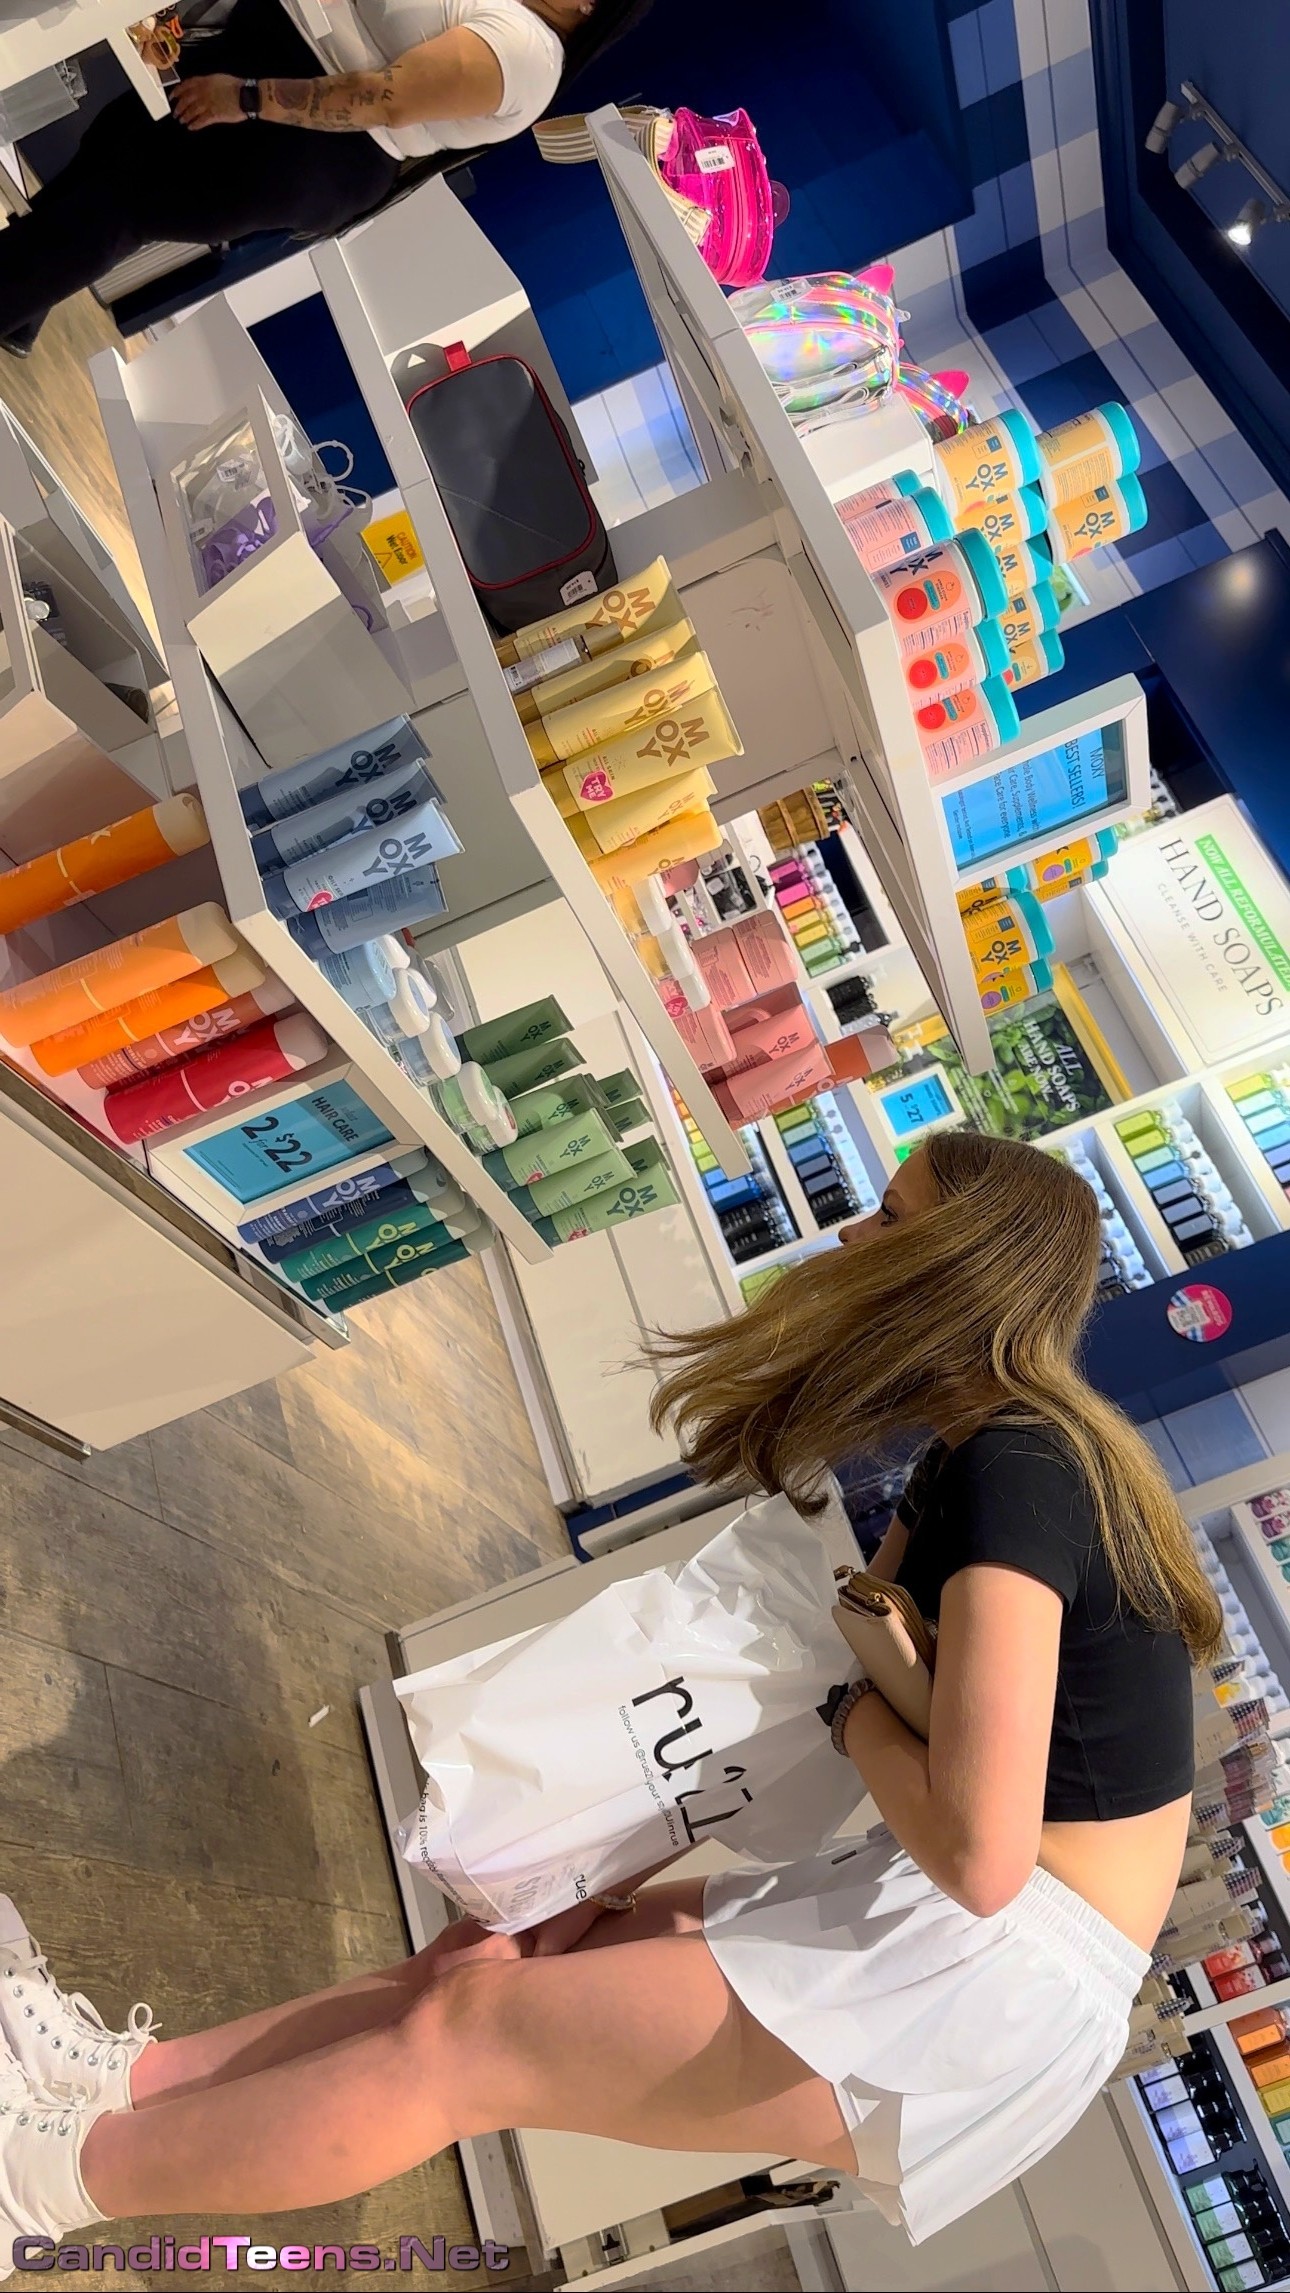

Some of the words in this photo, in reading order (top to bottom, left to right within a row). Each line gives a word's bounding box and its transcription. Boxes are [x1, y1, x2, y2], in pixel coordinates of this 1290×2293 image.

[979, 512, 1016, 542] MOX
[386, 535, 397, 549] Wet
[398, 531, 417, 559] CAUTION
[1000, 620, 1032, 645] MOX
[635, 715, 710, 767] MOXY
[1063, 738, 1080, 765] BEST
[605, 765, 615, 781] SKIN
[1020, 759, 1031, 775] hole
[1088, 747, 1104, 780] MOXY
[584, 784, 596, 798] ME
[589, 776, 606, 799] TRY
[994, 786, 1005, 802] Care
[1007, 773, 1018, 793] Care,
[1023, 774, 1035, 792] Body
[1067, 764, 1086, 809] SELLERS!
[997, 800, 1007, 812] for
[1009, 790, 1025, 831] Supplements,
[1024, 790, 1039, 819] Wellness
[998, 810, 1012, 838] everyone
[361, 832, 433, 877] MOXY
[1202, 840, 1221, 865] NOW
[1216, 866, 1235, 888] ALL
[327, 874, 337, 888] OILY
[1158, 884, 1190, 929] CLEANSE
[1188, 933, 1207, 962] WITH
[1205, 964, 1228, 992] CARE
[1159, 837, 1224, 921] HAND
[1214, 928, 1283, 1016] SOAPS
[1016, 1040, 1038, 1068] ARE
[1021, 1017, 1056, 1066] HAND
[1044, 1062, 1081, 1113] SOAPS
[1052, 1043, 1083, 1076] ALL
[900, 1092, 913, 1103] 5
[311, 1095, 339, 1122] HAIR
[332, 1116, 359, 1143] CARE
[239, 1113, 281, 1141] 2
[262, 1130, 313, 1175] $22
[605, 1184, 658, 1218] MOXY
[617, 1705, 635, 1734] follow
[629, 1736, 640, 1748] us
[643, 1778, 660, 1801] your
[418, 1790, 428, 1812] bag
